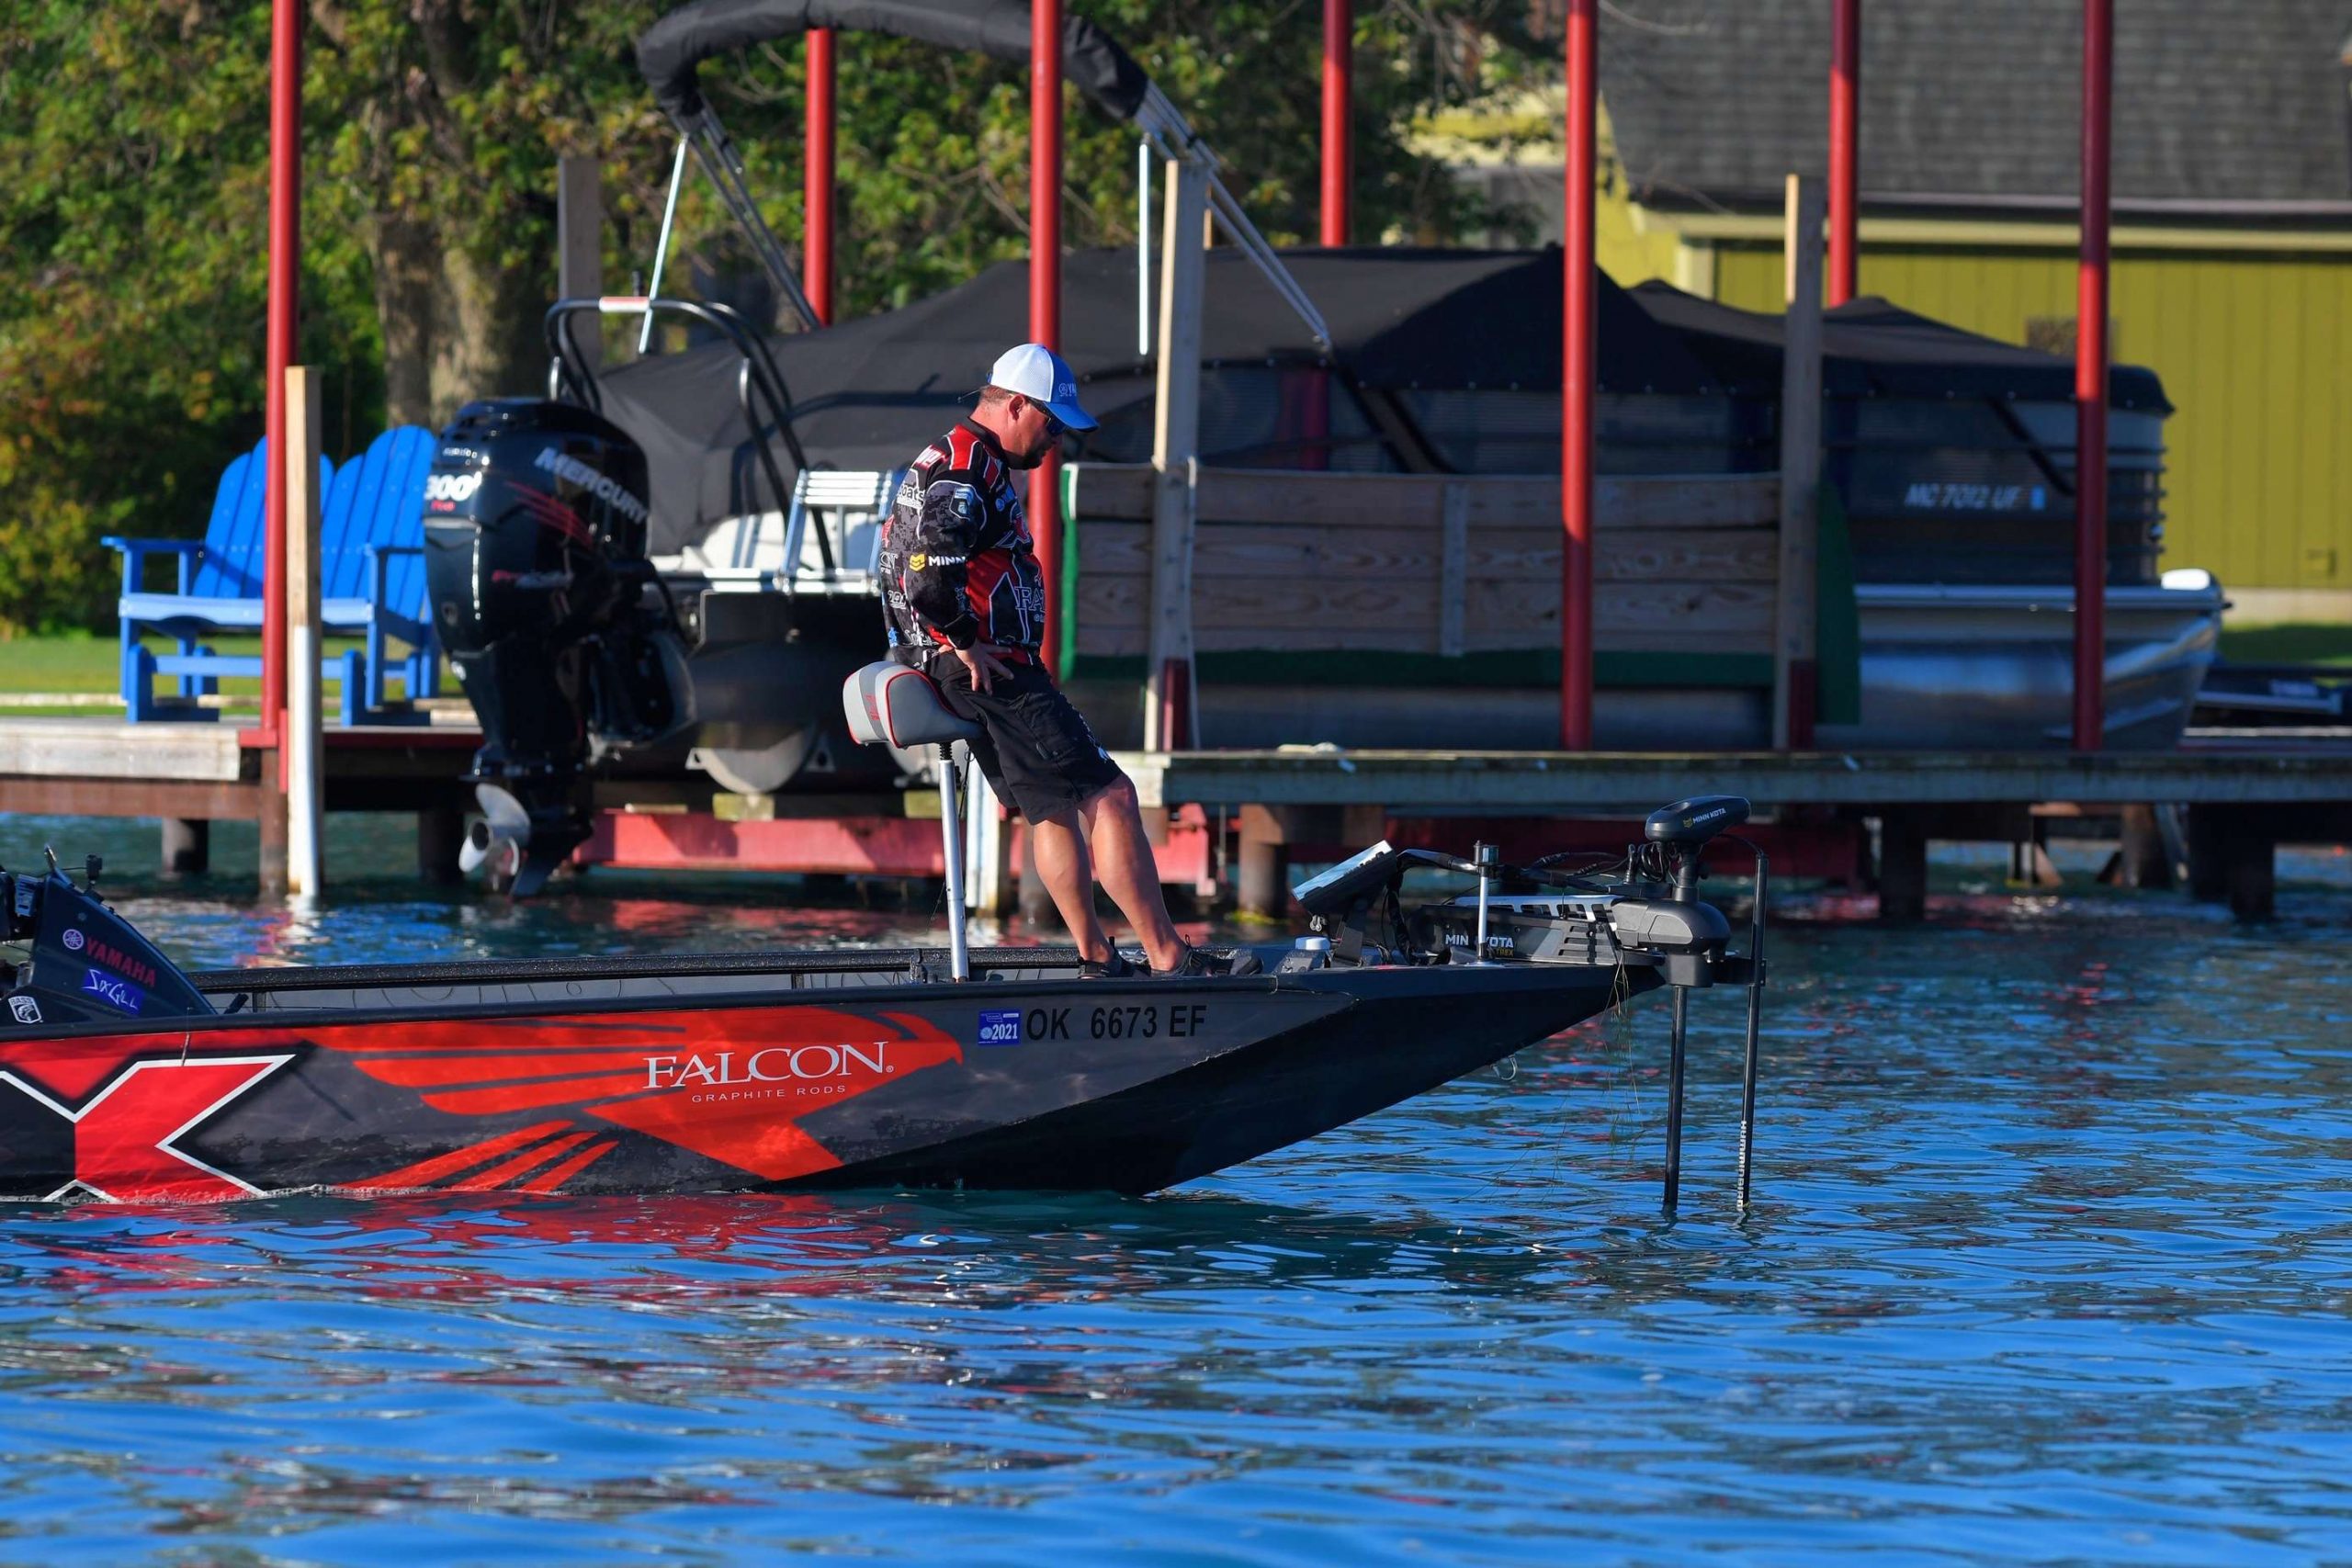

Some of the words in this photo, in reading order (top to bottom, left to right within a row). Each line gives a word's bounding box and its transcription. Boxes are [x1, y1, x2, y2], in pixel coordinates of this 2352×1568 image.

[534, 446, 648, 525] MERCURY
[1692, 813, 1710, 823] MINN
[1709, 807, 1727, 818] KOTA
[1445, 934, 1469, 946] MIN
[86, 935, 156, 987] YAMAHA
[991, 1023, 1018, 1040] 2021
[1026, 1008, 1071, 1041] OK
[1091, 1006, 1158, 1039] 6673
[1169, 1004, 1208, 1037] EF
[643, 1041, 888, 1089] FALCON
[692, 1089, 786, 1103] GRAPHITE
[796, 1084, 846, 1096] RODS
